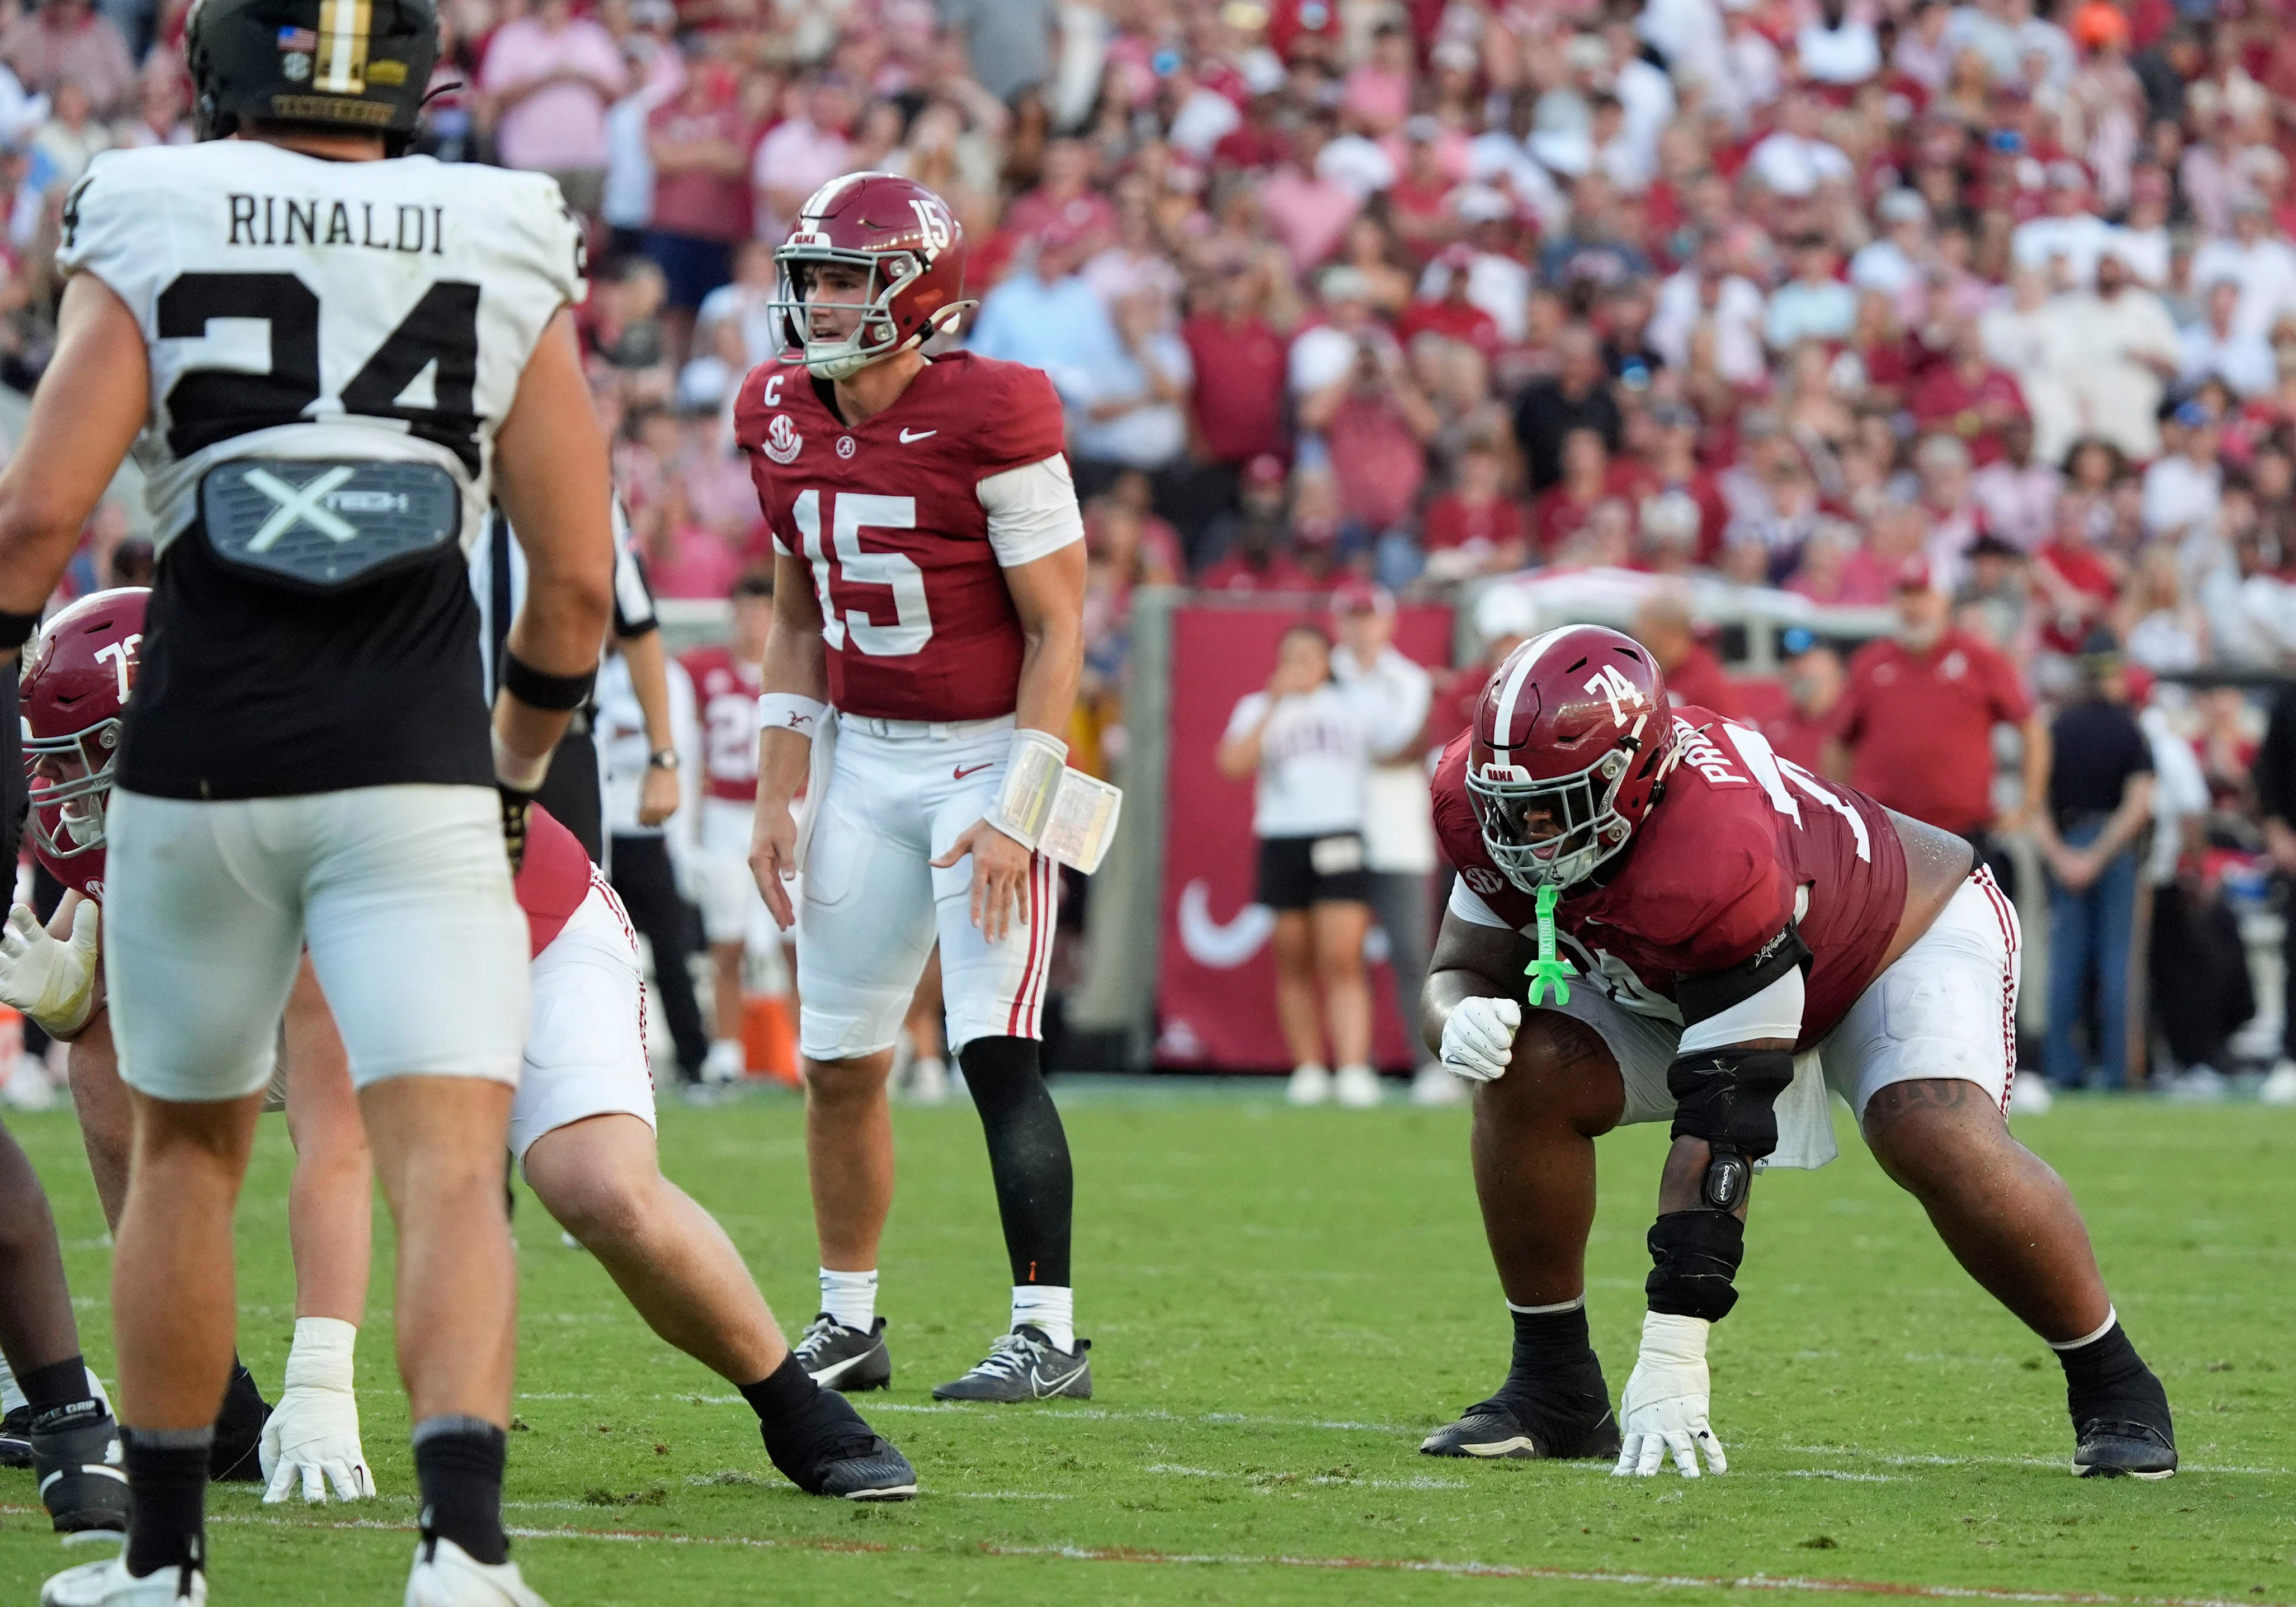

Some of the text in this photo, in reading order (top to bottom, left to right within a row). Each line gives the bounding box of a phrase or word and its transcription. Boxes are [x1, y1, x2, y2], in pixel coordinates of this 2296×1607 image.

[227, 193, 444, 256] RINALDI
[908, 199, 949, 248] 15
[158, 272, 487, 482] 24
[763, 375, 784, 407] C
[768, 414, 799, 450] SEC
[769, 447, 798, 462] GRADUATE
[792, 489, 934, 657] 15
[1583, 664, 1645, 729] 74
[1487, 769, 1514, 782] BAMA
[1465, 867, 1503, 894] SEC
[1539, 918, 1553, 955] NXTRND
[1760, 930, 1787, 956] Douglas
[1719, 1165, 1731, 1201] DONJOY
